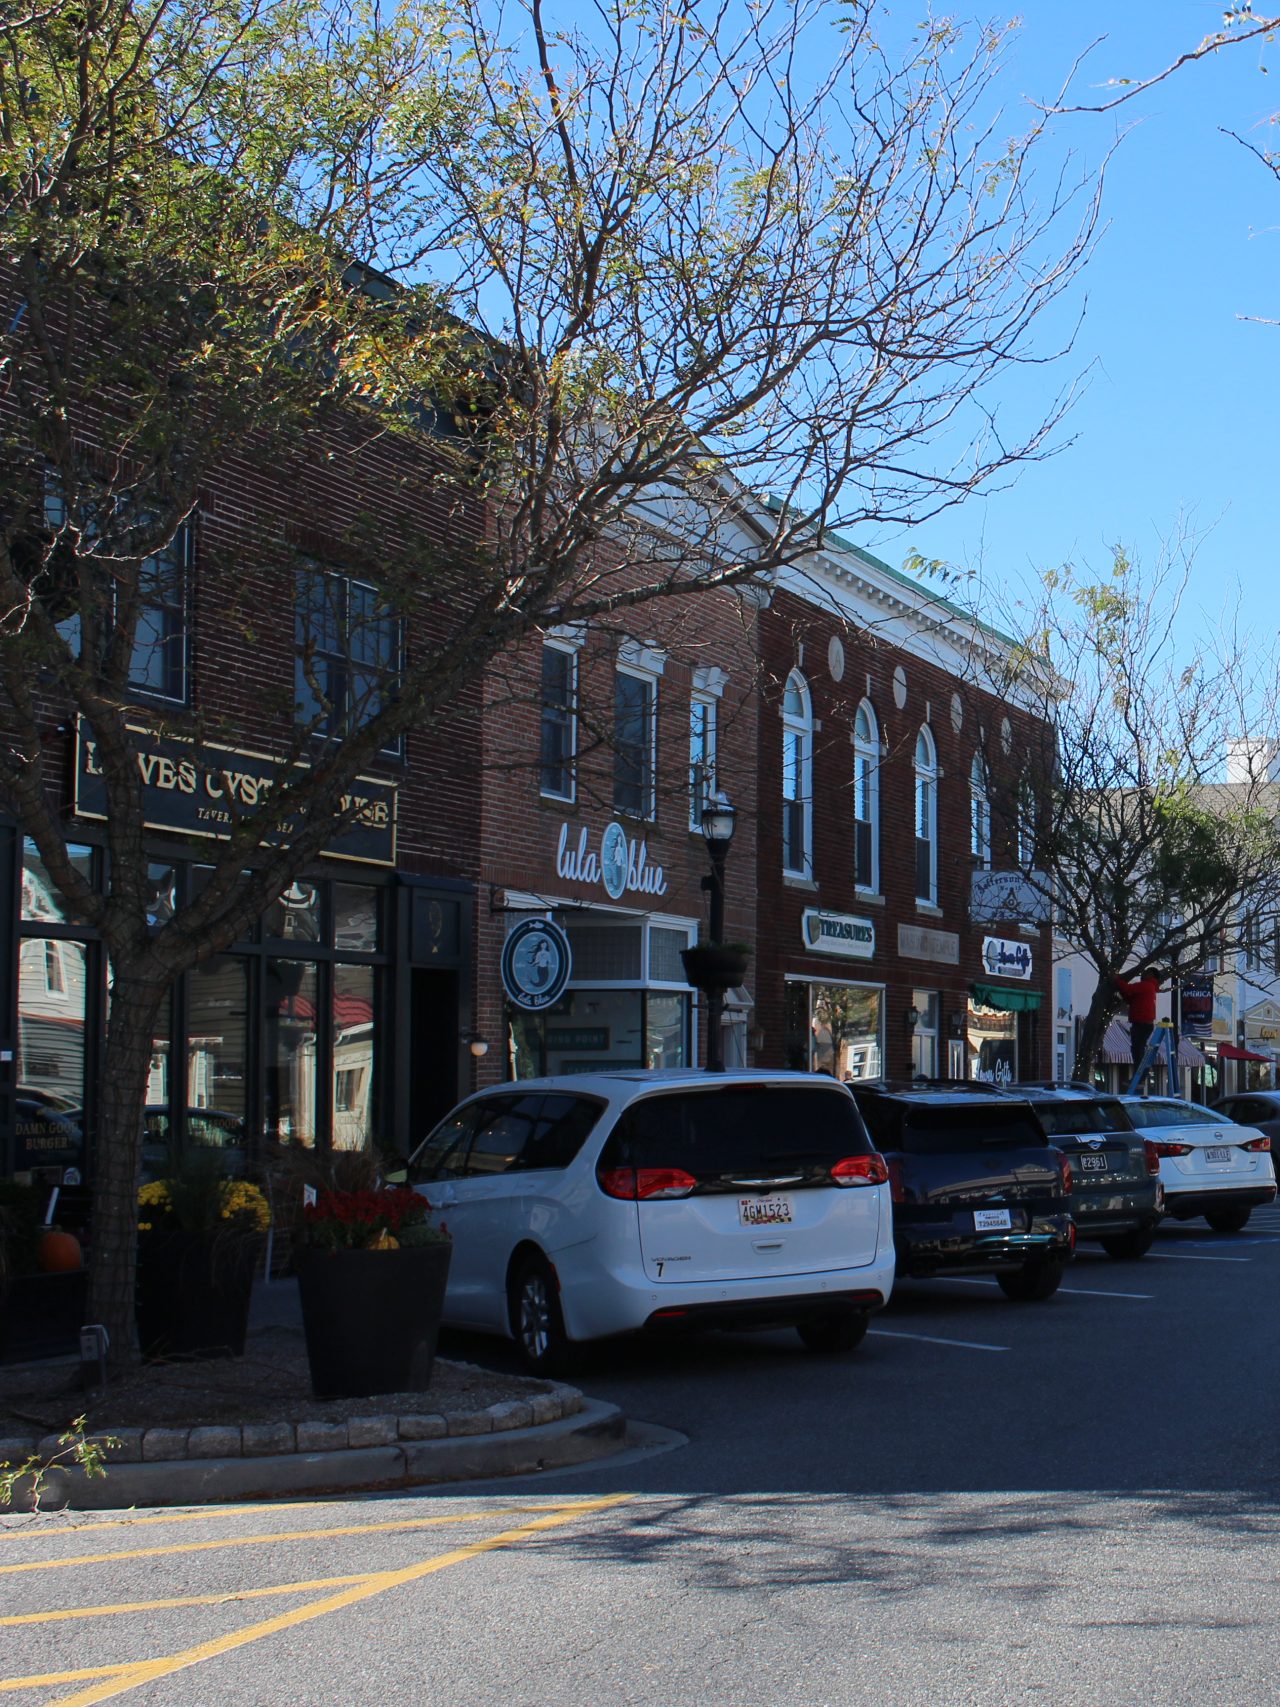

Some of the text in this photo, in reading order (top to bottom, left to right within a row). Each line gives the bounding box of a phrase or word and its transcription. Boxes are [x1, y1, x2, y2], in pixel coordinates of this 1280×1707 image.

[198, 808, 236, 824] TAVER
[557, 822, 667, 895] lula blue
[820, 919, 873, 943] TREASURES
[656, 1262, 664, 1277] 7
